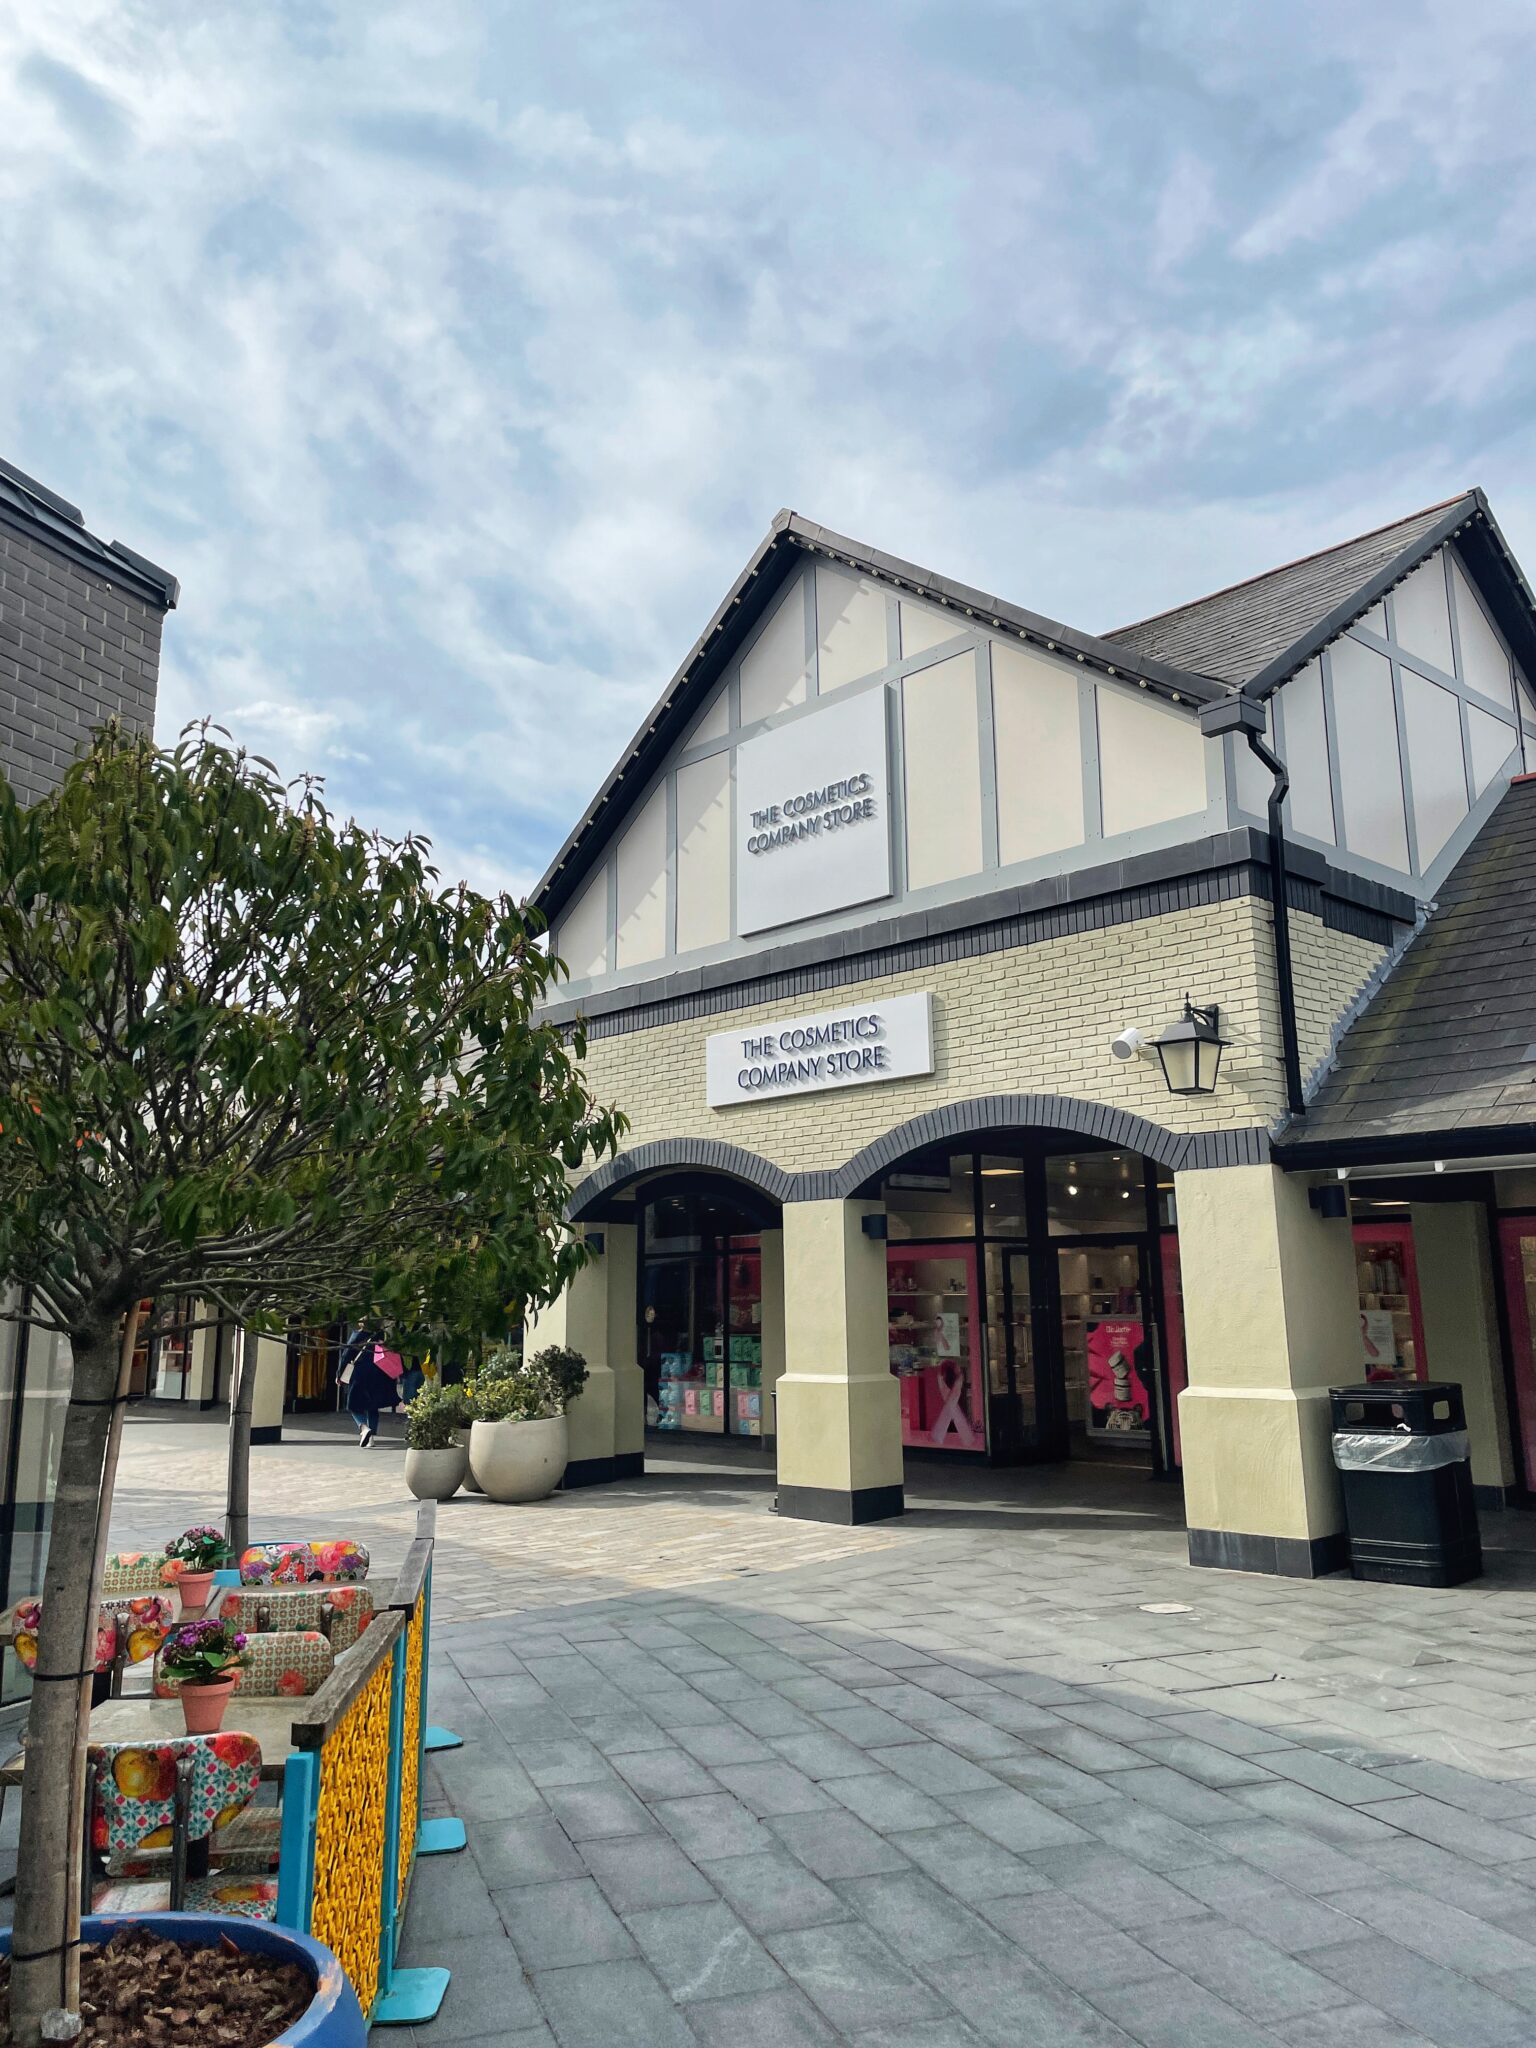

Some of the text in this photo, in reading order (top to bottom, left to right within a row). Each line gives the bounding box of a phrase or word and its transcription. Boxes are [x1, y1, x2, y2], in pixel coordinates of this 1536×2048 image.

[750, 773, 869, 828] THE COSMETICS
[747, 798, 873, 854] COMPANY STORE
[741, 1014, 878, 1058] THE COSMETICS
[738, 1045, 885, 1088] COMPANY STORE
